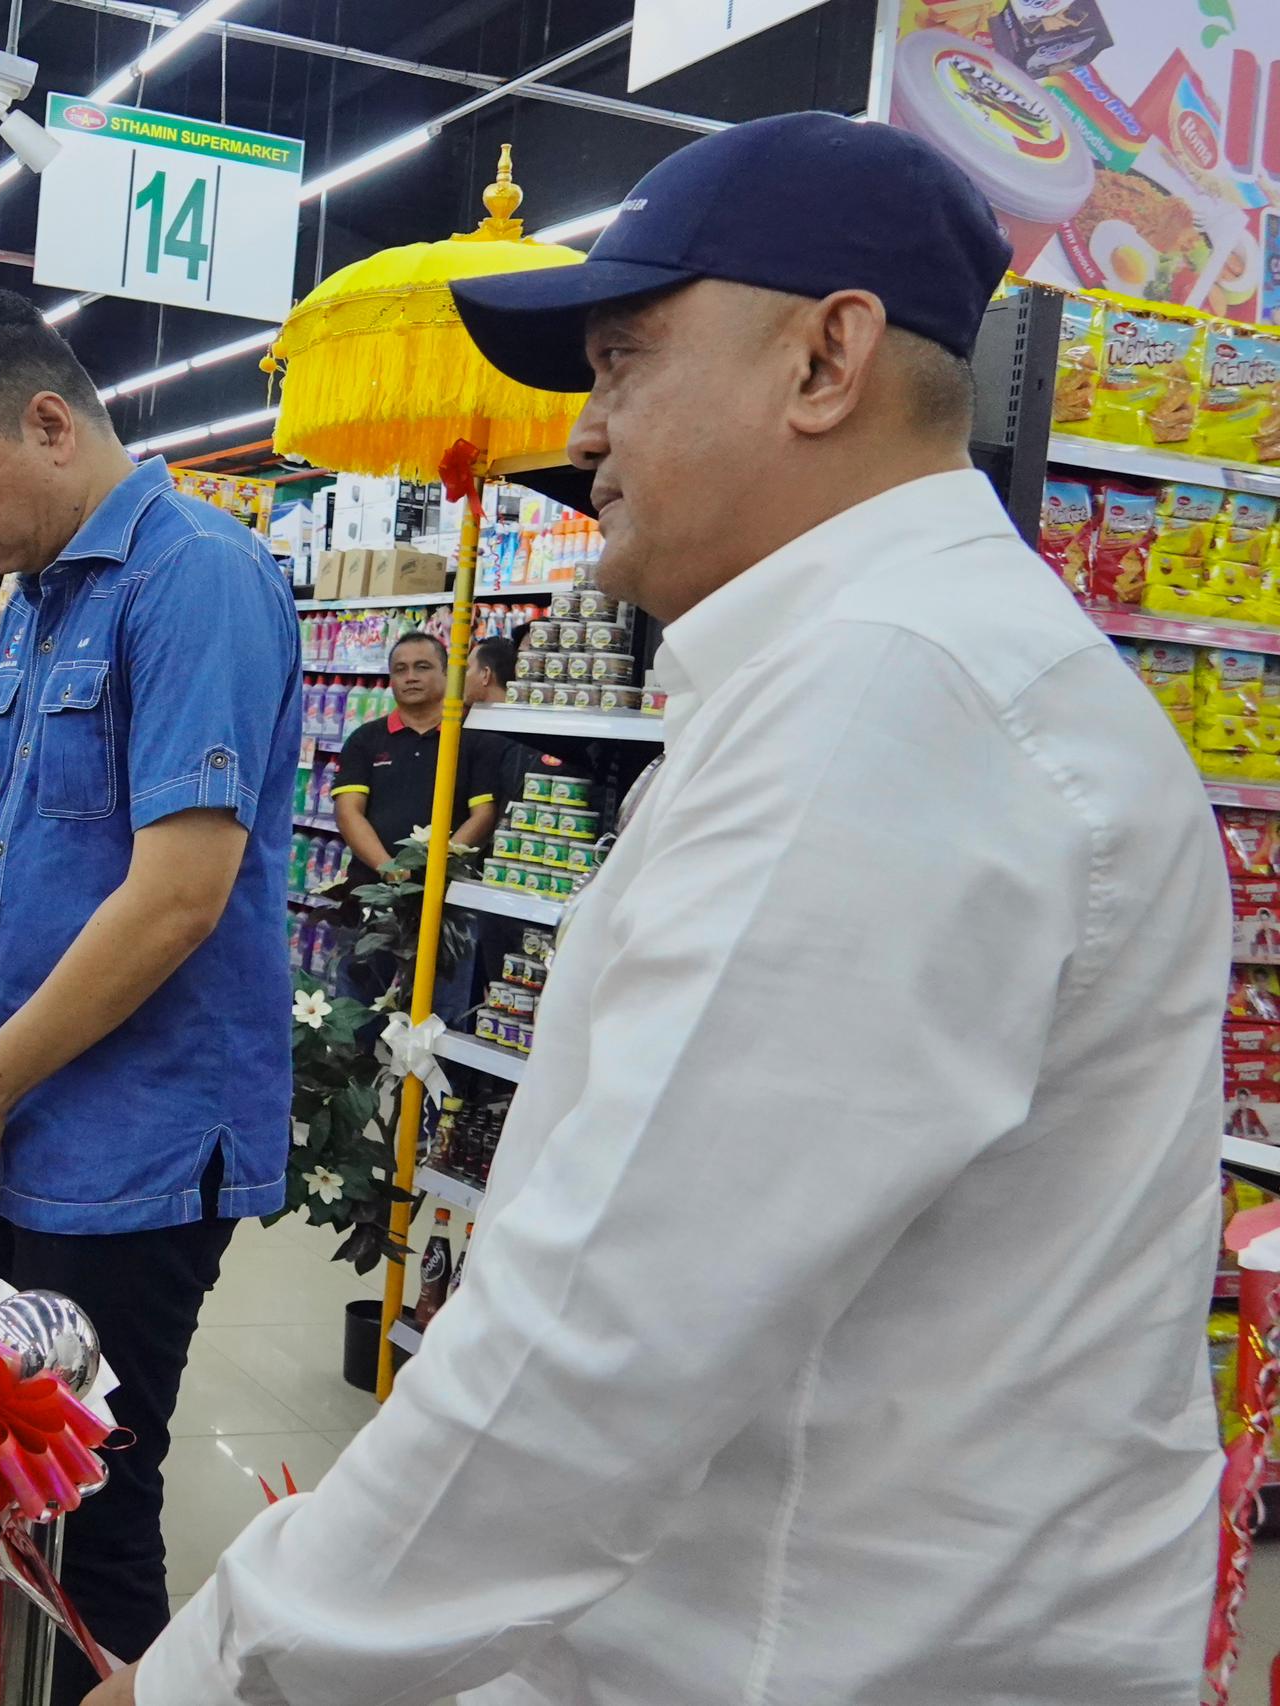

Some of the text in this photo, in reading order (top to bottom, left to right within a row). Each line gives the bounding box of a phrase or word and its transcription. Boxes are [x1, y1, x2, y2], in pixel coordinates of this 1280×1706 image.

[111, 117, 178, 141] STHAMIN
[181, 130, 290, 163] SUPERMARKET
[1180, 115, 1213, 164] Roma
[135, 169, 209, 281] 14
